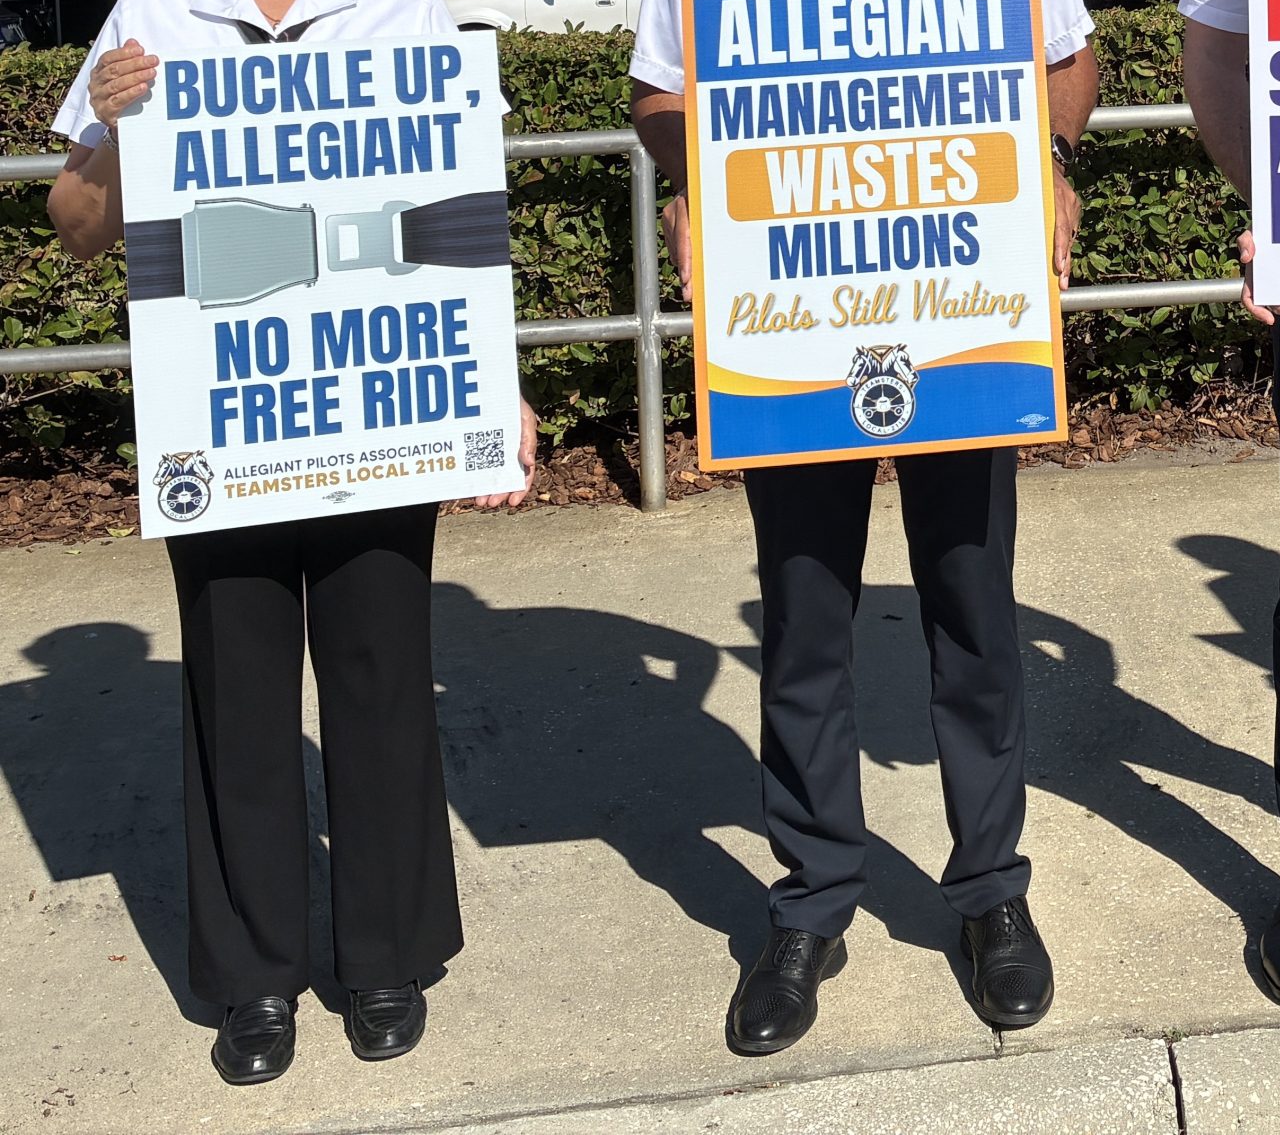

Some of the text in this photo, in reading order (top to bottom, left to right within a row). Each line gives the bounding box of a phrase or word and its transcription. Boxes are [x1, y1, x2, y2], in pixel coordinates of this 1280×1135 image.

[166, 46, 480, 120] BUCKLE UP,
[709, 70, 1024, 142] MANAGEMENT
[175, 113, 462, 191] ALLEGIANT
[764, 138, 979, 215] WASTES
[768, 213, 980, 280] MILLIONS
[215, 299, 470, 381] NO MORE
[726, 277, 1030, 336] Pilots Still Waiting
[210, 361, 480, 448] FREE RIDE
[862, 377, 904, 392] TEAMSTERS
[224, 440, 453, 481] ALLEGIANT PILOTS ASSOCIATION
[224, 470, 341, 499] TEAMSTERS
[347, 462, 410, 484] LOCAL
[415, 456, 457, 474] 2118
